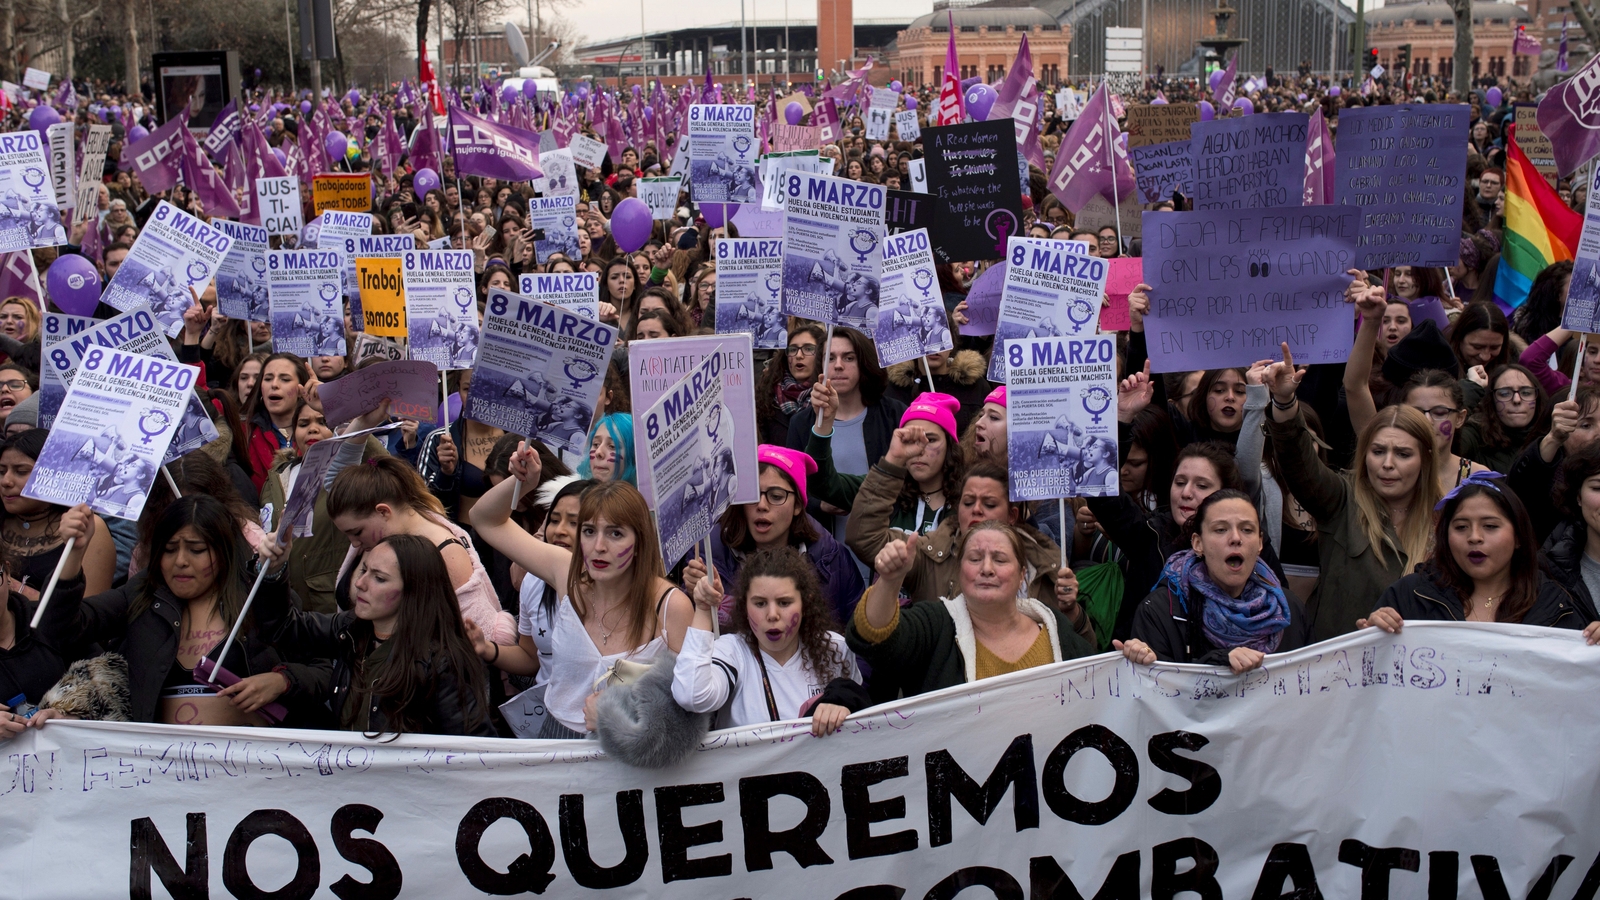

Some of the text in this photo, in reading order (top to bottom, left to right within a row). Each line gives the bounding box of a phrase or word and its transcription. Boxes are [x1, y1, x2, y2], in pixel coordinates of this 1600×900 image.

[690, 106, 752, 121] 8 MARZO
[897, 112, 915, 122] JUS-
[904, 123, 912, 132] TI-
[1351, 113, 1455, 135] LOS MEDIOS SUAVIZAN EL
[453, 125, 532, 162] CCOO
[901, 131, 917, 141] CIA!
[936, 135, 942, 147] A
[947, 134, 967, 145] Real
[1201, 128, 1249, 155] ALGUNOS
[1254, 124, 1306, 146] MACHOS
[1371, 137, 1434, 150] DOLOR CAUSADO
[456, 146, 487, 155] mujeres
[497, 148, 533, 166] igualdad
[1197, 147, 1290, 179] HERIDOS HABLAN
[1349, 154, 1440, 170] LLAMANDO LOCO AL
[260, 180, 296, 196] JUS-
[315, 180, 366, 193] Trabajadoras
[1198, 168, 1278, 200] DE HEMBRISMO,
[1350, 176, 1381, 189] CABRÓN
[1388, 174, 1403, 186] QUE
[1408, 174, 1418, 184] HA
[788, 175, 882, 209] 8 MARZO
[938, 183, 1001, 198] Is whatever the
[1355, 193, 1378, 206] TODOS
[1384, 192, 1397, 205] LOS
[1403, 191, 1441, 206] CANALES,
[1442, 195, 1456, 205] NO
[270, 199, 289, 214] TI-
[317, 197, 369, 209] somos TODAS.
[531, 196, 574, 210] 8 MARZO
[949, 201, 995, 213] hell she wants
[155, 205, 229, 252] 8 MARZO
[266, 216, 298, 233] CIA!
[324, 213, 370, 228] 8 MARZO
[964, 215, 981, 226] to be
[1365, 212, 1405, 228] ENFERMOS
[224, 223, 268, 244] MARZO
[1160, 221, 1217, 249] DEJA
[1228, 218, 1251, 244] DE
[1259, 214, 1353, 242] FOLLARME
[1372, 234, 1397, 246] HIJOS
[1402, 232, 1427, 245] SANOS
[1431, 234, 1450, 244] DEL
[345, 237, 412, 253] 8 MARZO
[718, 242, 728, 258] 8
[884, 232, 928, 255] ARZO
[268, 252, 338, 269] 8 MARZO
[405, 252, 472, 270] 8 MARZO
[1012, 245, 1103, 281] 8 MARZO
[1161, 249, 1348, 284] CON LOS CUANDO
[522, 275, 594, 293] 8 MARZO
[1158, 290, 1345, 318] PASO POR LA CALLE SOLA
[366, 311, 399, 328] somos
[490, 294, 508, 316] 8
[516, 300, 611, 346] MARZO
[487, 321, 516, 335] CONTRA
[530, 334, 566, 349] VIOLENCIA
[567, 344, 604, 360] MACHISTA
[488, 314, 519, 329] HUELGA
[521, 324, 556, 339] GENERAL
[557, 334, 605, 353] ESTUDIANTIL
[1161, 323, 1318, 354] EN TODO MOMENTO
[51, 349, 70, 370] 8
[1008, 339, 1112, 367] 8 MARZO
[85, 349, 192, 390] 8 MARZO
[1010, 364, 1111, 376] HUELGA GENERAL ESTUDIANTIL
[1011, 376, 1035, 384] CONTRA
[1048, 374, 1079, 382] VIOLENCIA
[1081, 372, 1112, 381] MACHISTA
[76, 378, 103, 390] CONTRA
[114, 386, 147, 400] VIOLENCIA
[147, 394, 180, 407] MACHISTA
[79, 370, 108, 382] HUELGA
[107, 376, 140, 390] GENERAL
[140, 384, 184, 399] ESTUDIANTIL
[642, 379, 668, 392] INICIA
[647, 413, 659, 440] 8
[663, 352, 720, 426] MARZO
[394, 399, 429, 417] TODAS
[1014, 468, 1069, 478] NOS QUEREMOS
[1014, 476, 1069, 488] VIVAS, LIBRES
[1021, 485, 1070, 496] COMBATIVAS
[130, 804, 402, 900] NOS
[455, 723, 1222, 896] QUEREMOS
